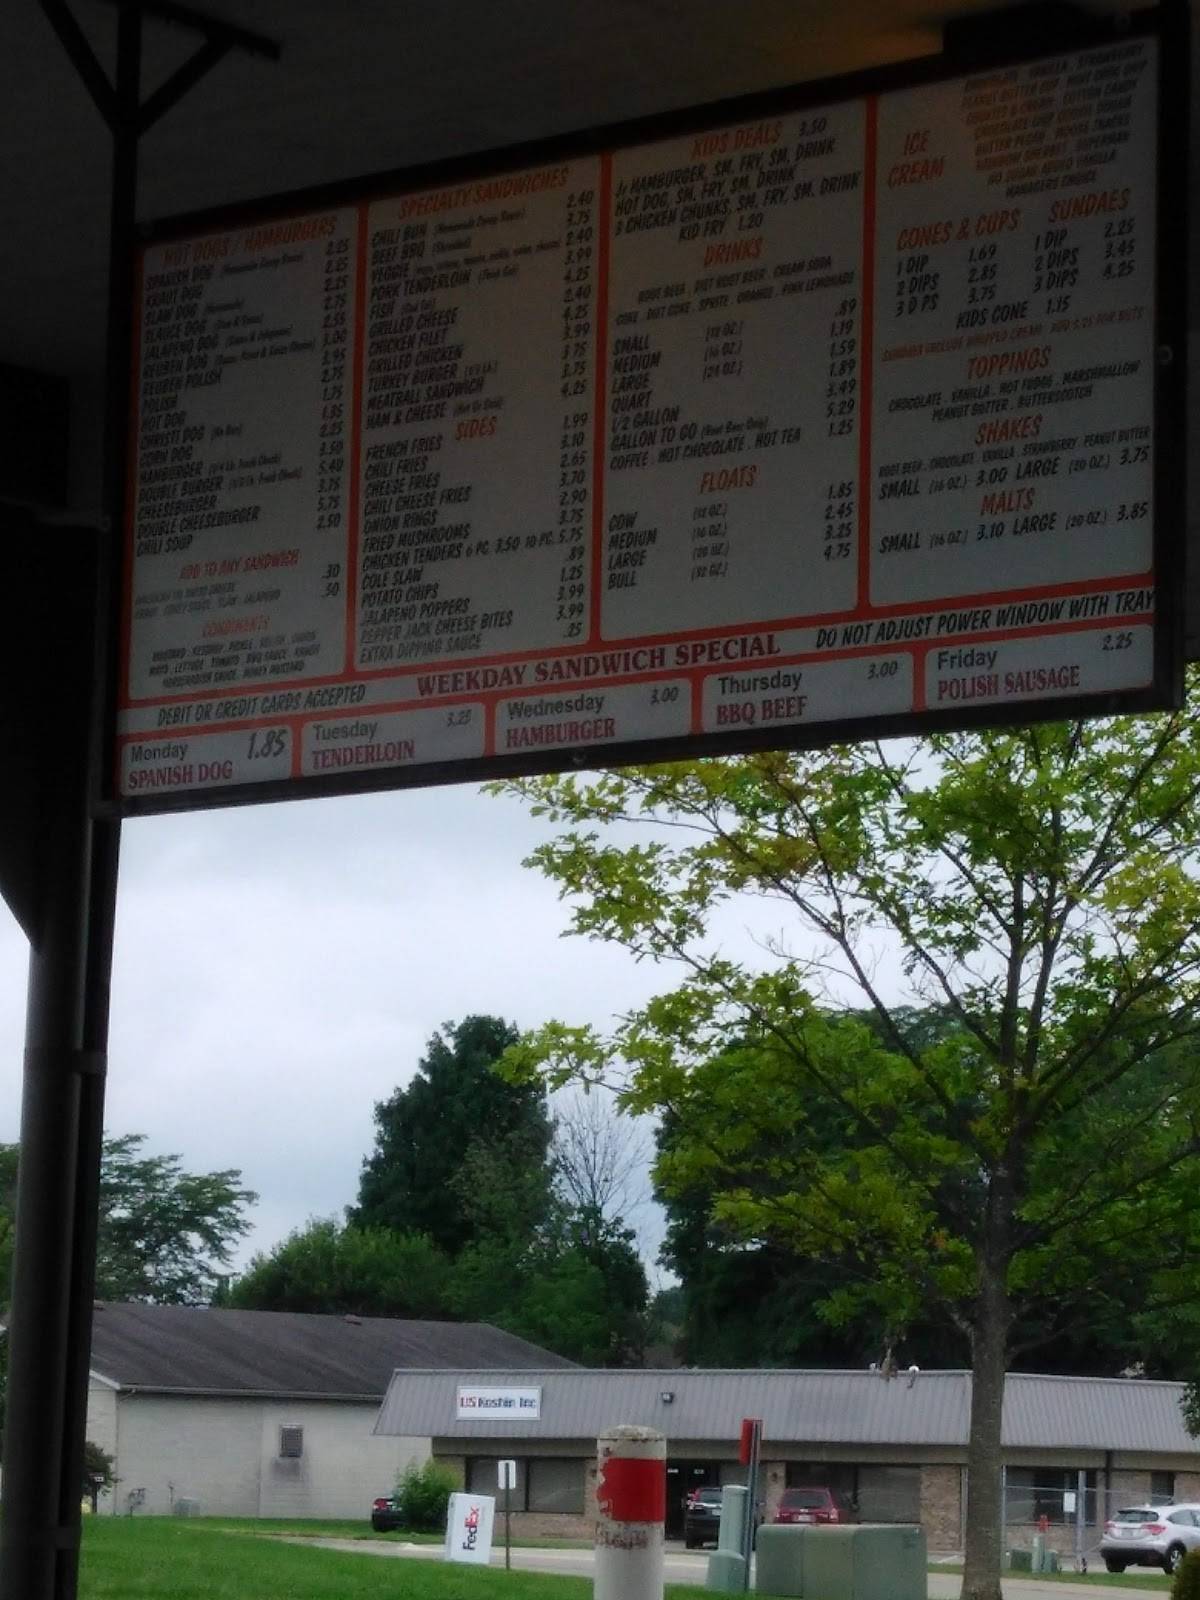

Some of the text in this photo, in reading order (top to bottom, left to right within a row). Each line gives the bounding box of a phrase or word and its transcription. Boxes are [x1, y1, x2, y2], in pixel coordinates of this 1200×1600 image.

[692, 122, 782, 159] KIDS DEALS
[796, 138, 835, 161] DRINK
[904, 130, 930, 155] ICE
[757, 166, 795, 189] DRINK
[888, 157, 944, 188] CREAM
[626, 173, 860, 233] CHICKEN DRINK
[1049, 187, 1130, 223] SUNDAES
[679, 223, 699, 242] KID
[704, 218, 725, 237] FRY
[897, 208, 1022, 250] CONES CUPS
[1045, 229, 1066, 249] DIP
[704, 236, 763, 267] DRINKS
[906, 255, 928, 274] DIP
[1047, 249, 1079, 269] DIPS
[909, 274, 939, 294] DIPS
[1047, 269, 1078, 290] DIPS
[957, 301, 1027, 329] KIDS CONE
[613, 334, 649, 356] SMALL
[613, 352, 660, 374] MEDIUM
[967, 346, 1050, 380] TOPPINGS
[612, 392, 651, 413] QUART
[456, 416, 496, 440] SIDES
[633, 406, 679, 428] GALLON
[975, 414, 1042, 446] SHAKES
[366, 441, 407, 461] FRENCH
[411, 435, 442, 454] FRIES
[610, 429, 656, 451] GALLON
[658, 446, 679, 463] HOT
[683, 436, 744, 460] CHOCOLATE
[755, 431, 777, 449] HOT
[781, 428, 800, 445] TEA
[397, 456, 427, 475] FRIES
[365, 472, 439, 498] CHEESE FRIES
[700, 465, 756, 494] FLOATS
[879, 478, 919, 500] SMALL
[976, 465, 1006, 486] 3.00
[1016, 458, 1060, 481] LARGE
[395, 491, 436, 512] CHEESE
[439, 486, 471, 505] FRIES
[980, 487, 1034, 516] MALTS
[609, 513, 636, 531] COW
[879, 532, 920, 554] SMALL
[1013, 513, 1056, 536] LARGE
[609, 530, 656, 550] MEDIUM
[413, 543, 462, 564] TENDERS
[608, 551, 646, 570] LARGE
[362, 567, 422, 590] COLE SLAW
[608, 572, 636, 590] BULL
[361, 588, 401, 608] POTATO
[405, 583, 438, 602] CHIPS
[480, 611, 512, 629] BITES
[816, 589, 1154, 648] DO NOT ADJUST POWER WINDOW WITH TRAY
[416, 633, 780, 697] WEEKDAY SANDWICH SPECIAL
[867, 661, 897, 679] 3.00
[937, 645, 997, 674] Friday
[718, 668, 801, 698] Thursday
[938, 665, 1079, 701] POLISH SAUSAGE
[158, 684, 365, 726] DEBIT OR CREDIT CARDS ACCEPTED
[507, 692, 604, 723] Wednesday
[716, 695, 807, 728] BBQ BEEF
[247, 729, 287, 759] 1.85
[312, 718, 377, 746] Tuesday
[506, 717, 615, 748] HAMBURGER
[131, 740, 187, 764] Monday
[312, 739, 415, 769] TENDERLOIN
[129, 760, 232, 789] SPANISH DOG
[462, 1504, 479, 1550] FedEx
